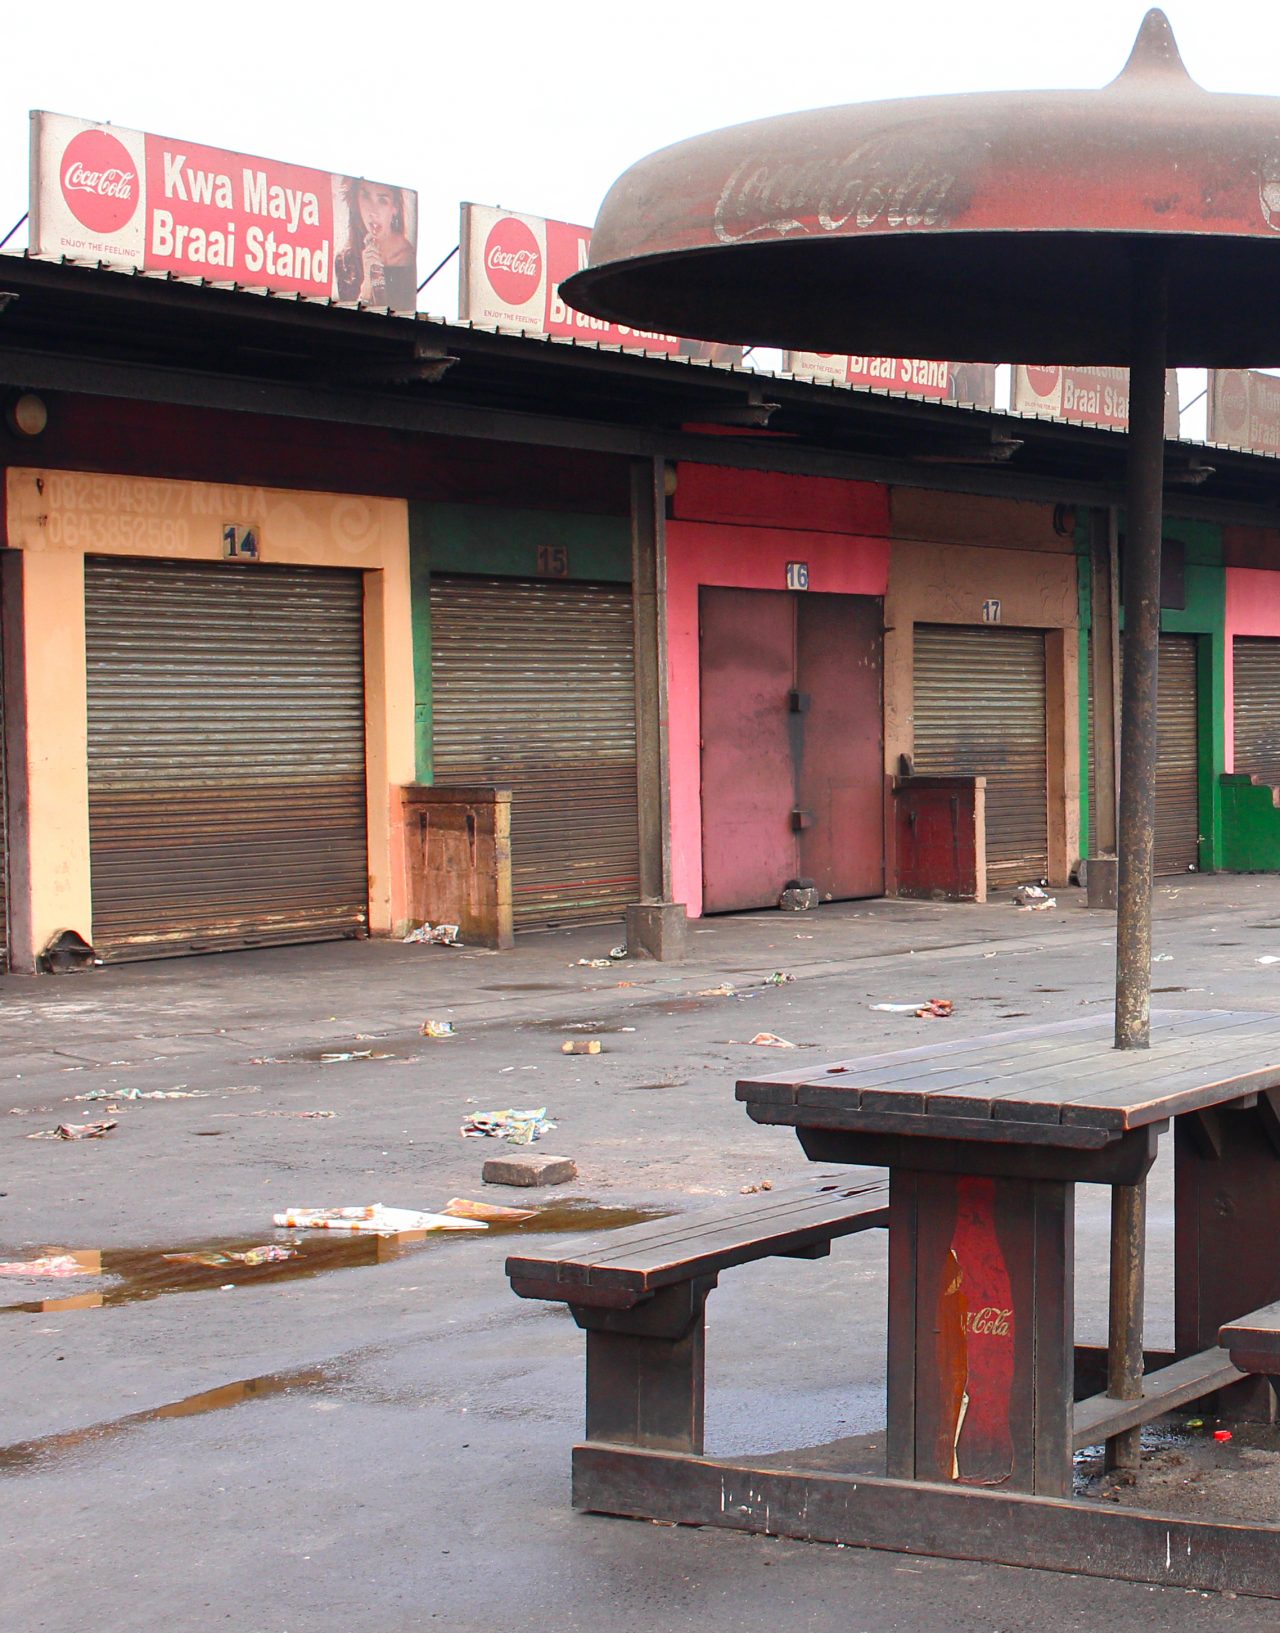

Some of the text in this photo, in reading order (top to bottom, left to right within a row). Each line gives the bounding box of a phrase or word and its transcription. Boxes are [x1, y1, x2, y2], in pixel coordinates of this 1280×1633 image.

[64, 162, 134, 200] Coca-Cola
[163, 152, 320, 234] Kwa Maya
[61, 238, 86, 249] ENJOY
[88, 242, 102, 251] THE
[151, 208, 329, 284] Braai Stand
[488, 245, 538, 276] Coca-Cola
[483, 310, 501, 319] ENJOY
[550, 283, 610, 331] Bra
[901, 359, 947, 388] Stand
[1064, 379, 1130, 418] Braai Sta
[224, 527, 257, 557] 14
[540, 547, 566, 574] 15
[788, 563, 808, 588] 16
[982, 601, 999, 622] 17
